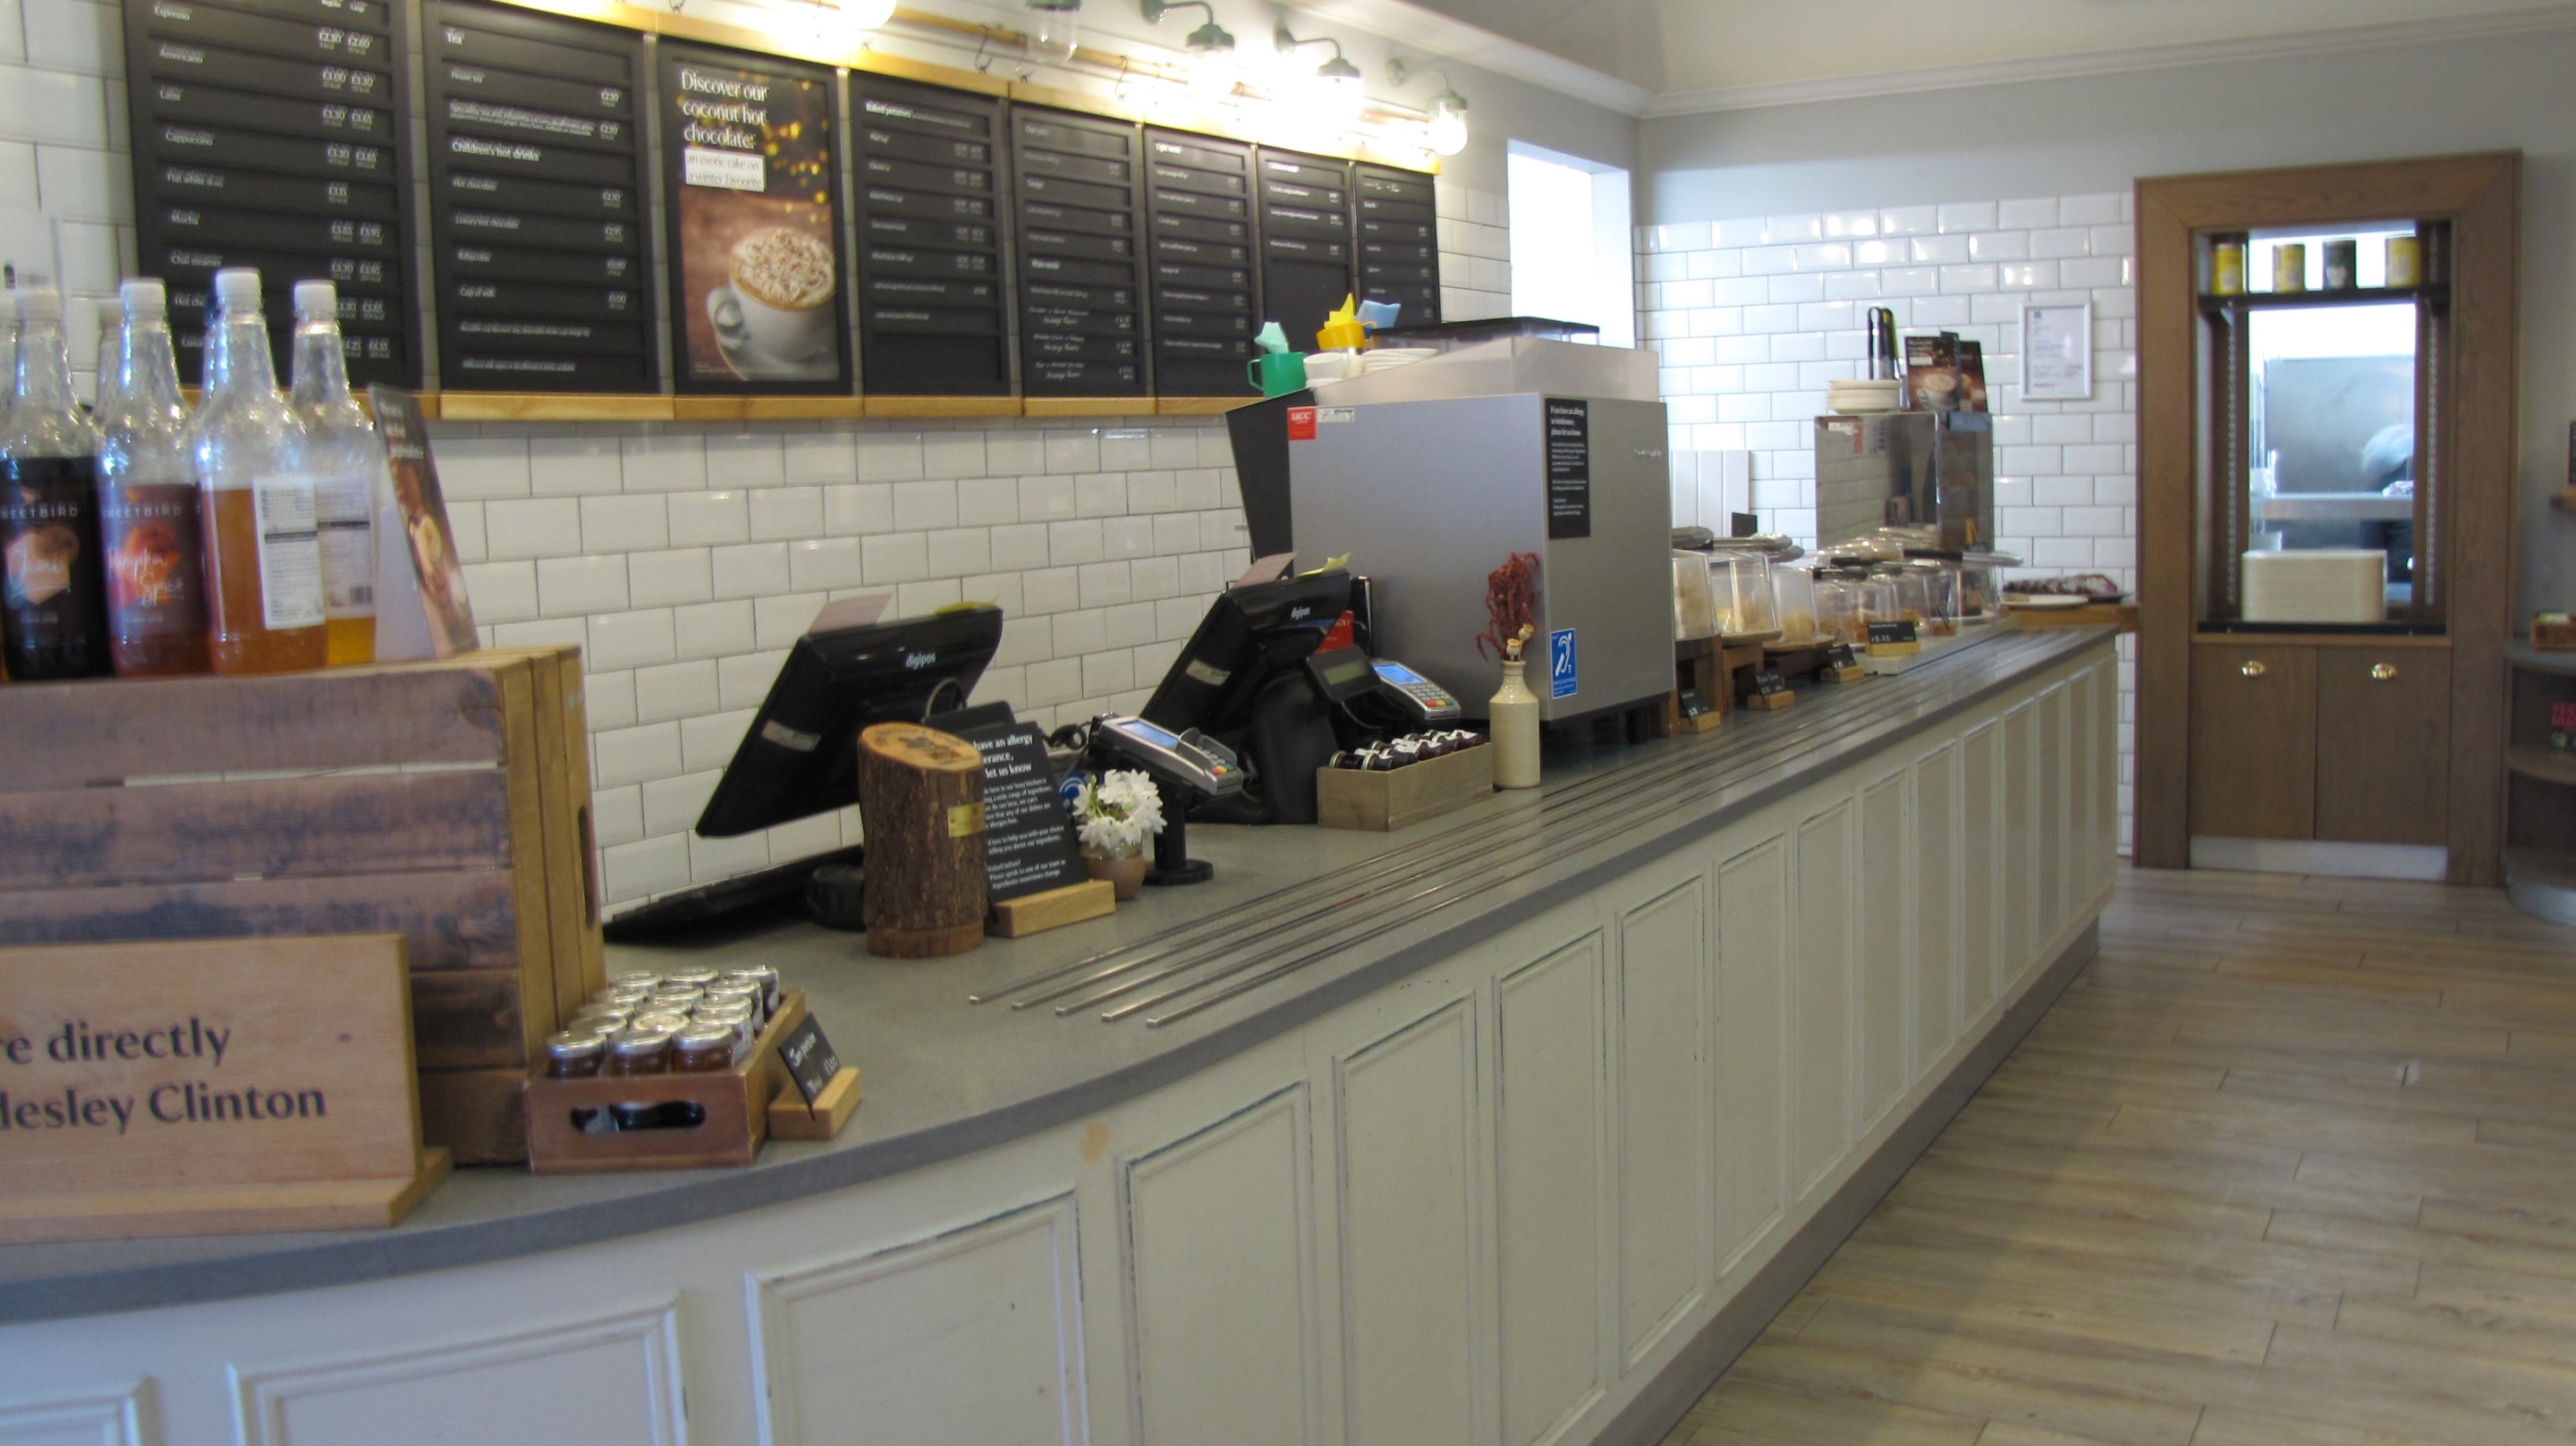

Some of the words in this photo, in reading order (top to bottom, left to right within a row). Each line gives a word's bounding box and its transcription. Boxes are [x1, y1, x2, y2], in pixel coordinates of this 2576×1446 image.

[682, 70, 741, 97] Discover
[742, 85, 768, 102] our
[682, 101, 740, 123] coconut
[741, 103, 767, 126] hot
[906, 651, 936, 670] digipos
[973, 740, 995, 751] have
[995, 738, 1006, 748] an
[1006, 733, 1033, 746] allergy
[983, 752, 1014, 765] erance,
[985, 766, 998, 779] let
[998, 767, 1009, 777] us
[1008, 763, 1032, 775] know
[48, 1016, 232, 1067] directly
[148, 1081, 327, 1124] Clinton
